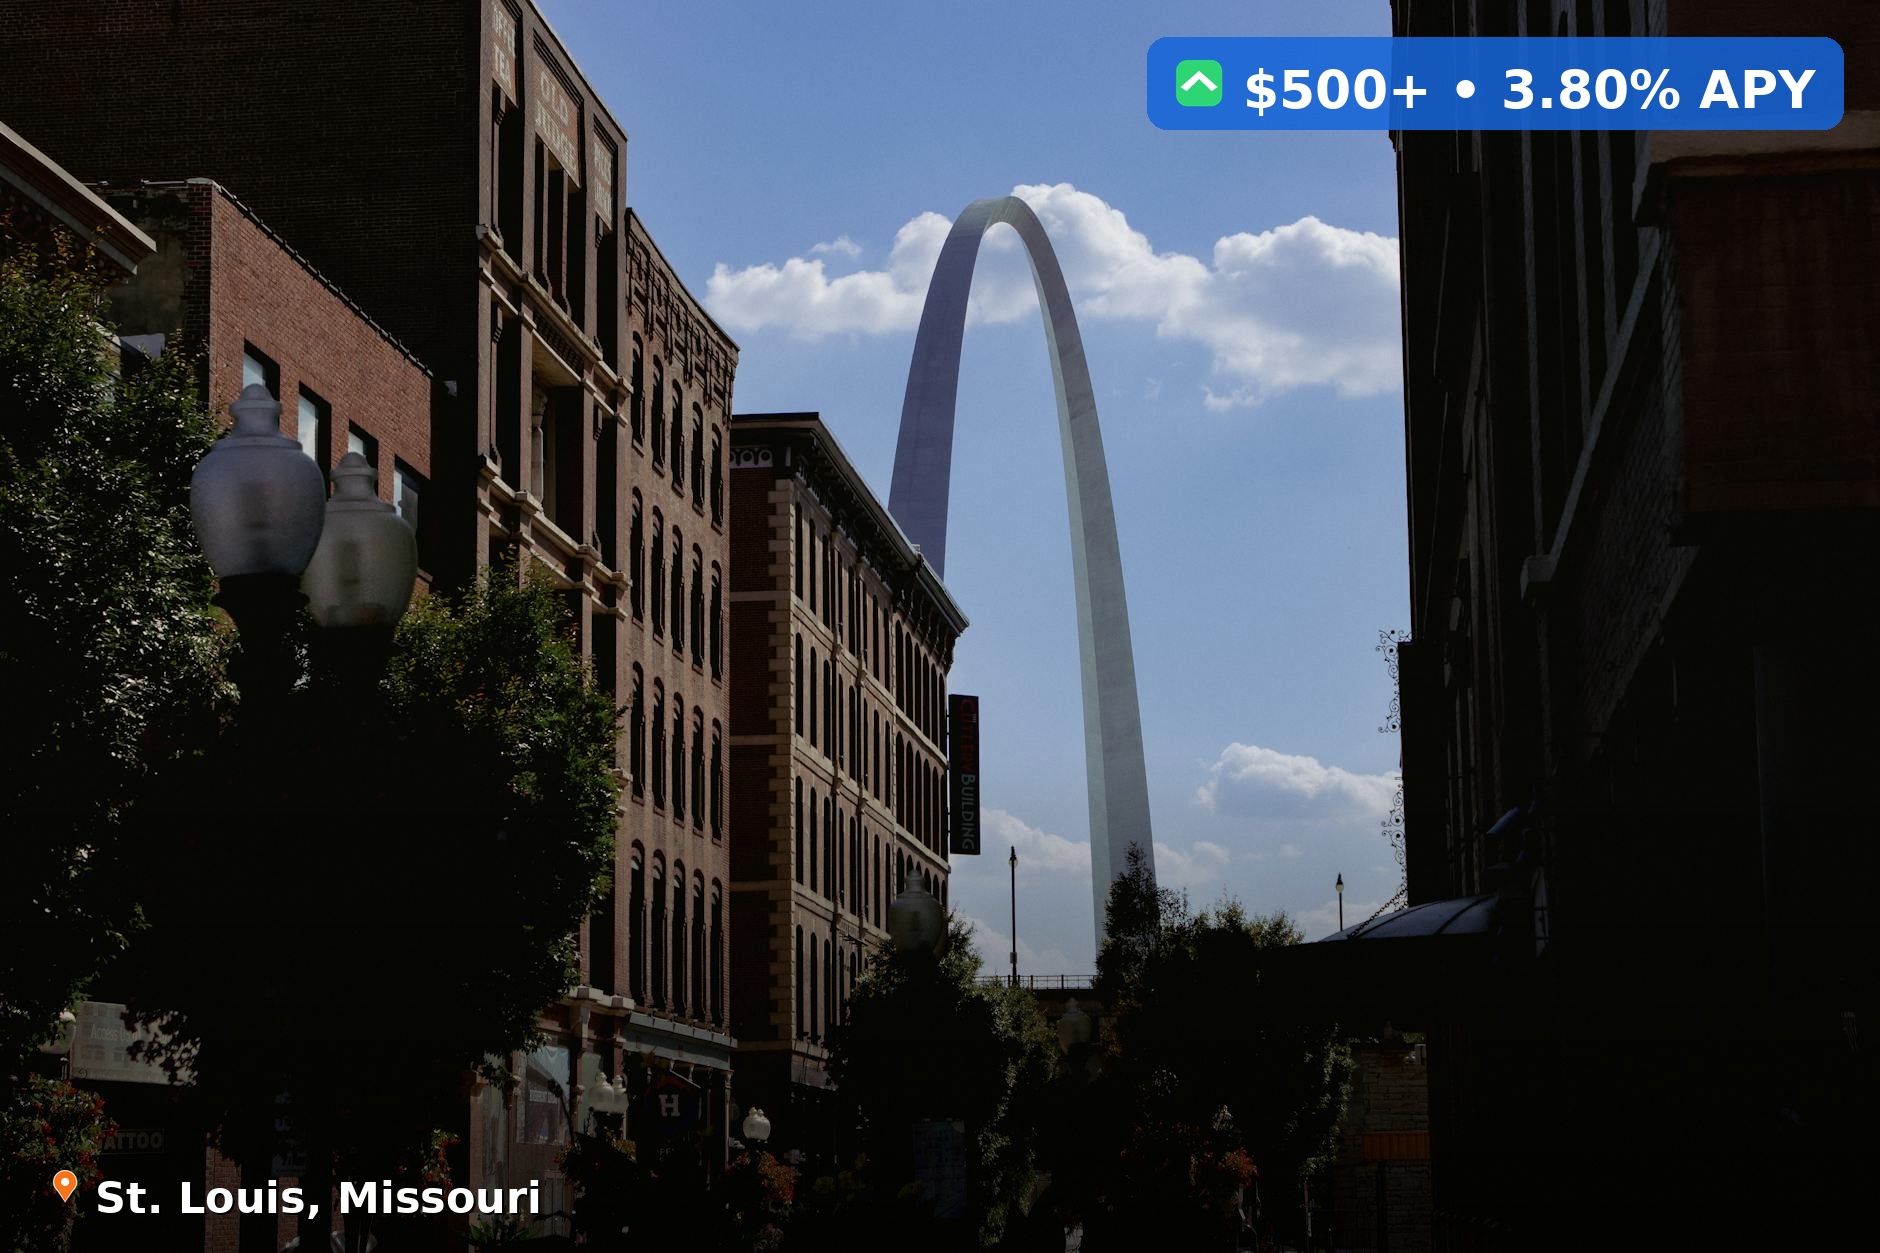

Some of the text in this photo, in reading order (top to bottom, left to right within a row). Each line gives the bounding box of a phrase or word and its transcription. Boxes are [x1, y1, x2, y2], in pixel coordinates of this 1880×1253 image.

[541, 71, 568, 127] OLD
[536, 99, 577, 171] JUDGE
[961, 773, 976, 850] BUILDING
[90, 1023, 120, 1040] Access
[658, 1093, 681, 1118] H
